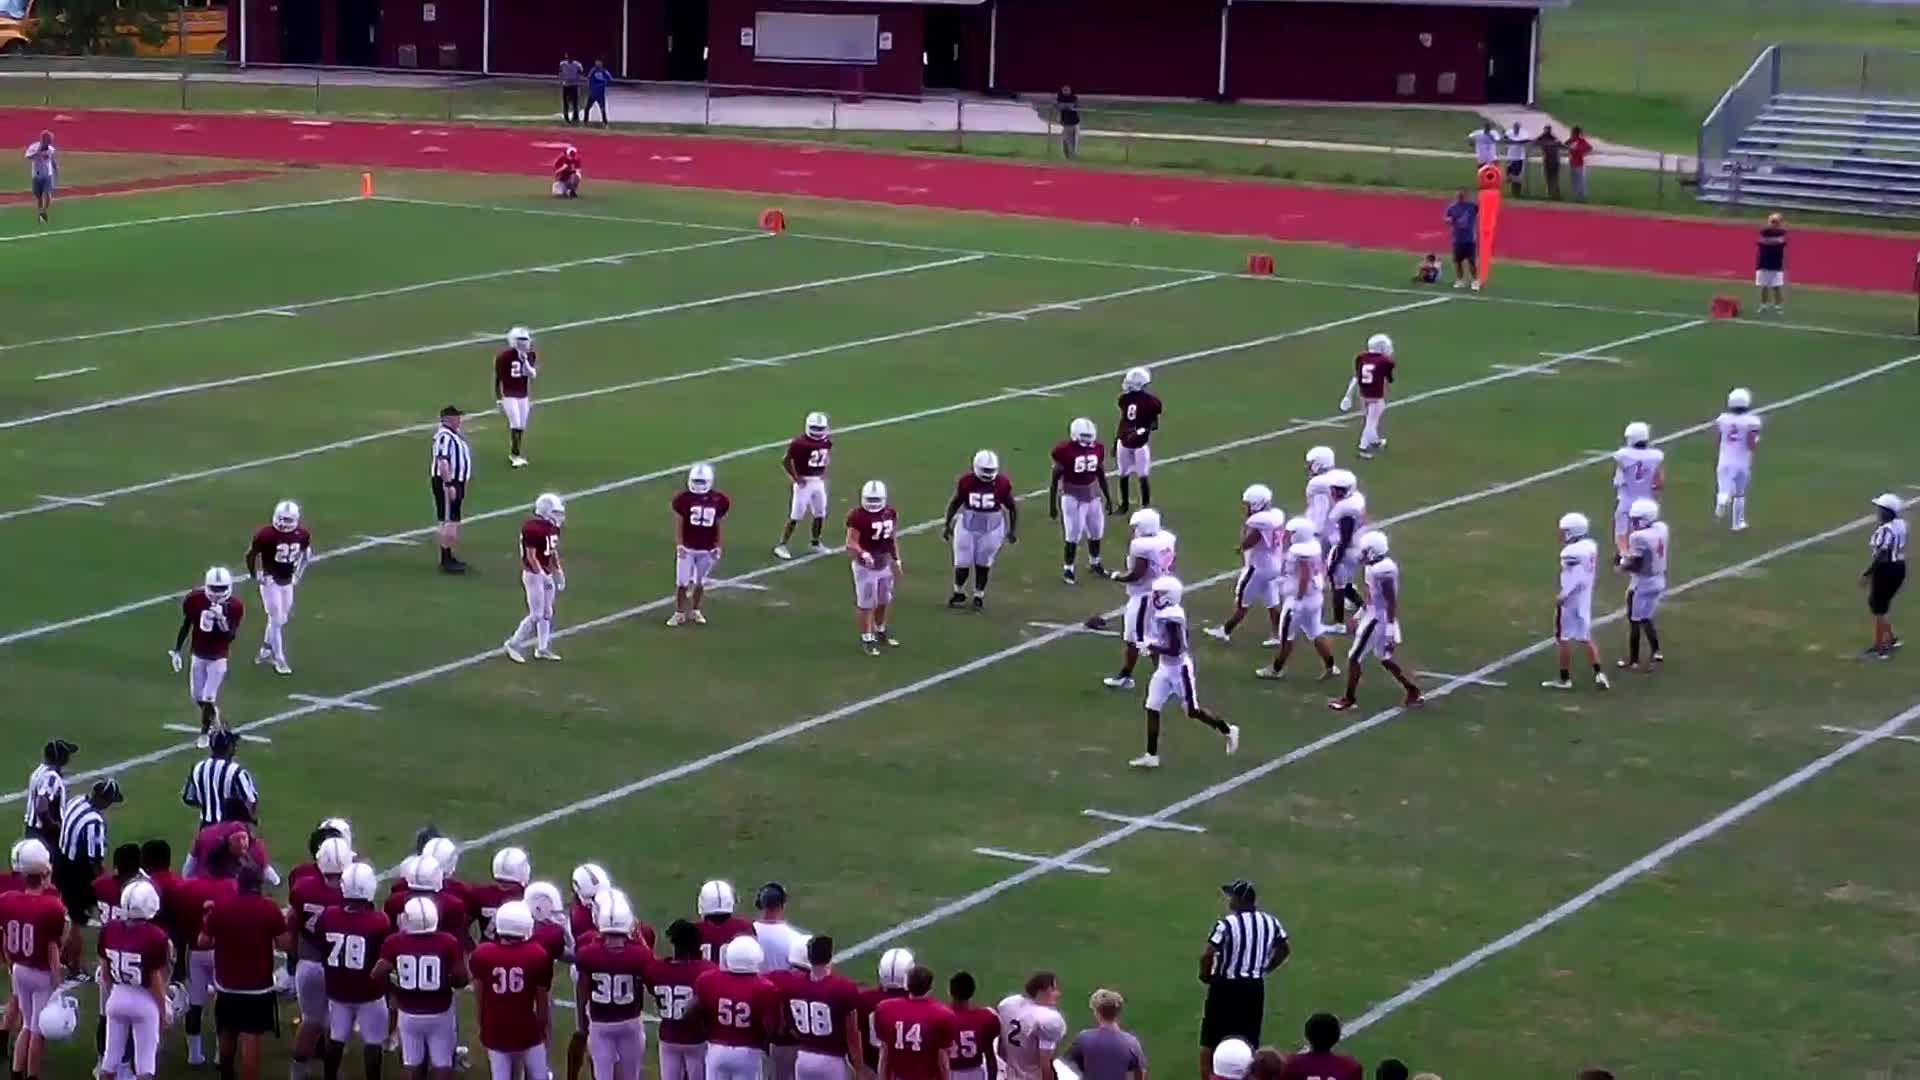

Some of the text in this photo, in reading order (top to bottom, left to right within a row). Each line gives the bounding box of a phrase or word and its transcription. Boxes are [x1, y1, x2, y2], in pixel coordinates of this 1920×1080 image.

[1362, 363, 1376, 384] 5
[807, 448, 828, 468] 27
[689, 505, 716, 528] 29
[274, 542, 300, 564] 22
[302, 903, 325, 935] 7
[325, 932, 366, 970] 78
[492, 966, 524, 994] 36
[591, 972, 635, 1005] 30
[653, 985, 693, 1020] 32
[717, 997, 752, 1029] 52
[894, 1020, 922, 1052] 14
[1007, 1019, 1022, 1047] 2
